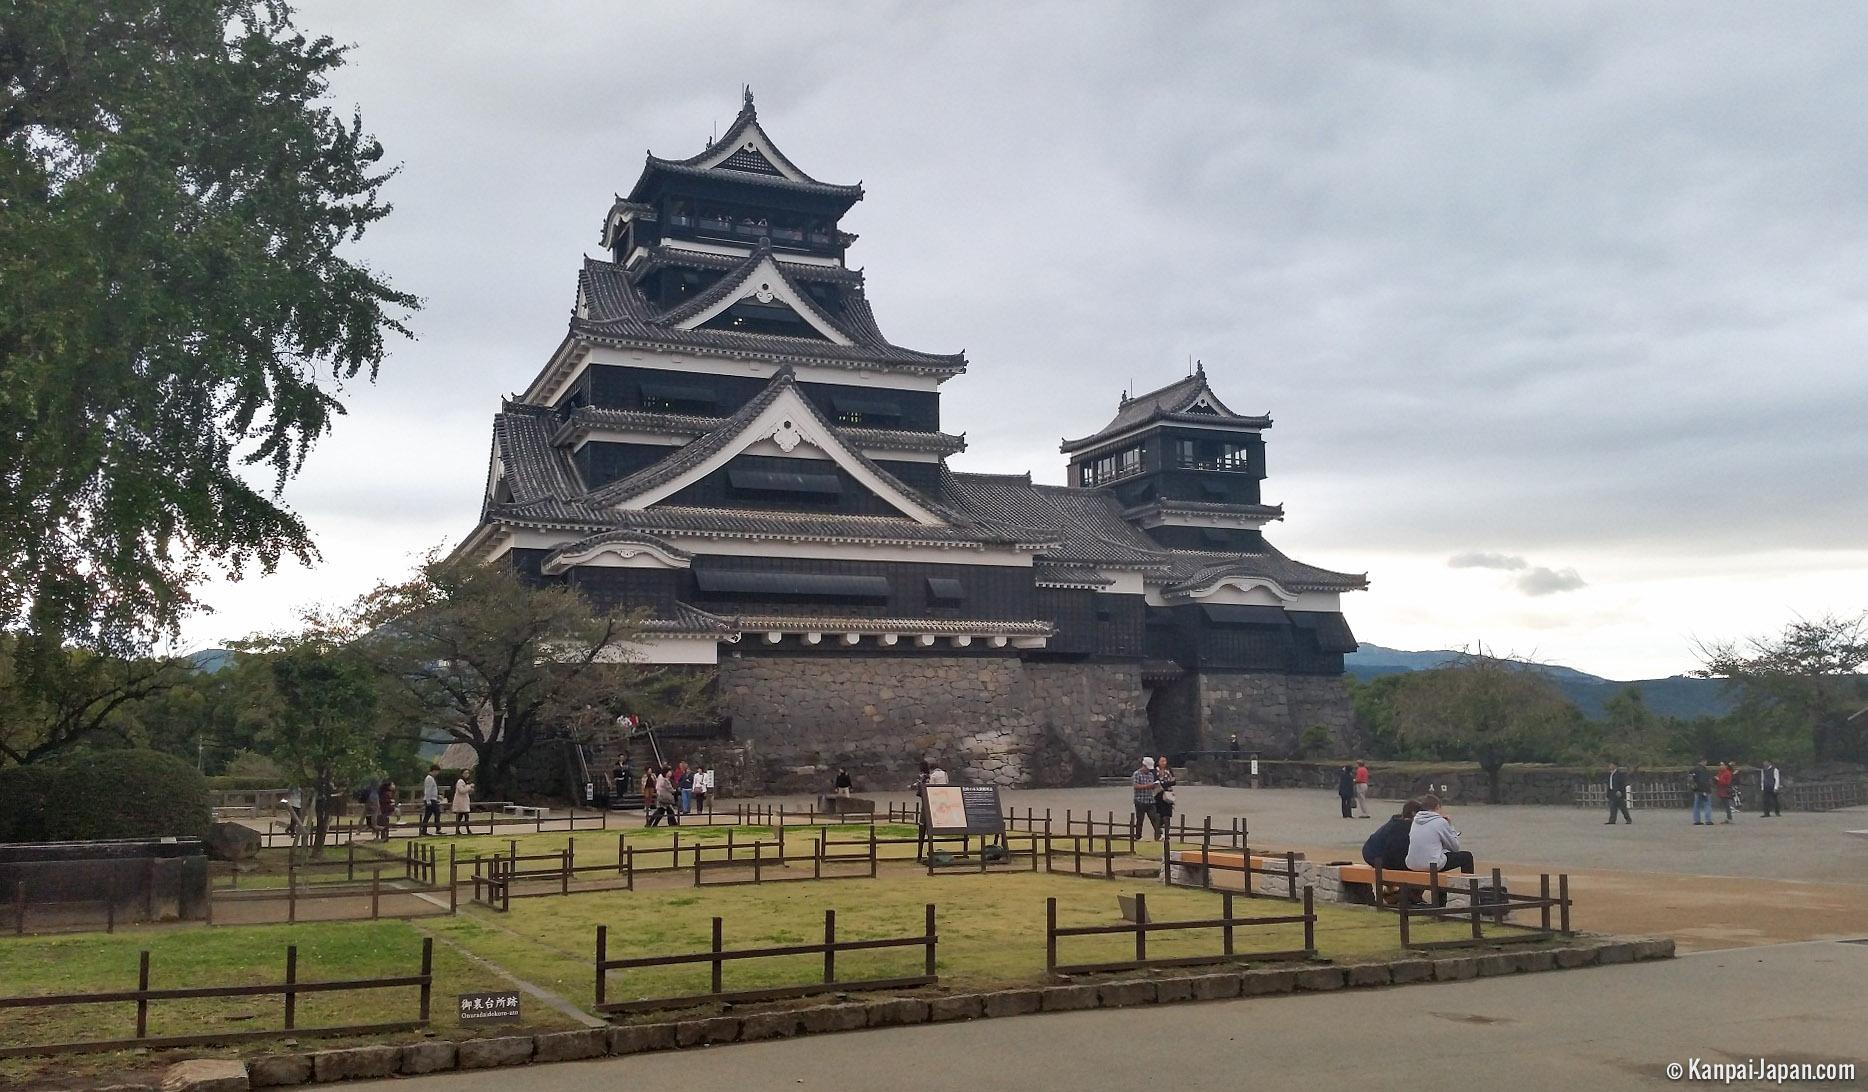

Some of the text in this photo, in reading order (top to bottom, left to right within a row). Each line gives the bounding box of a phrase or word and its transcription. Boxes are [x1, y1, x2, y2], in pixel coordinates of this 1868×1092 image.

[461, 996, 518, 1010] 御裏台所跡
